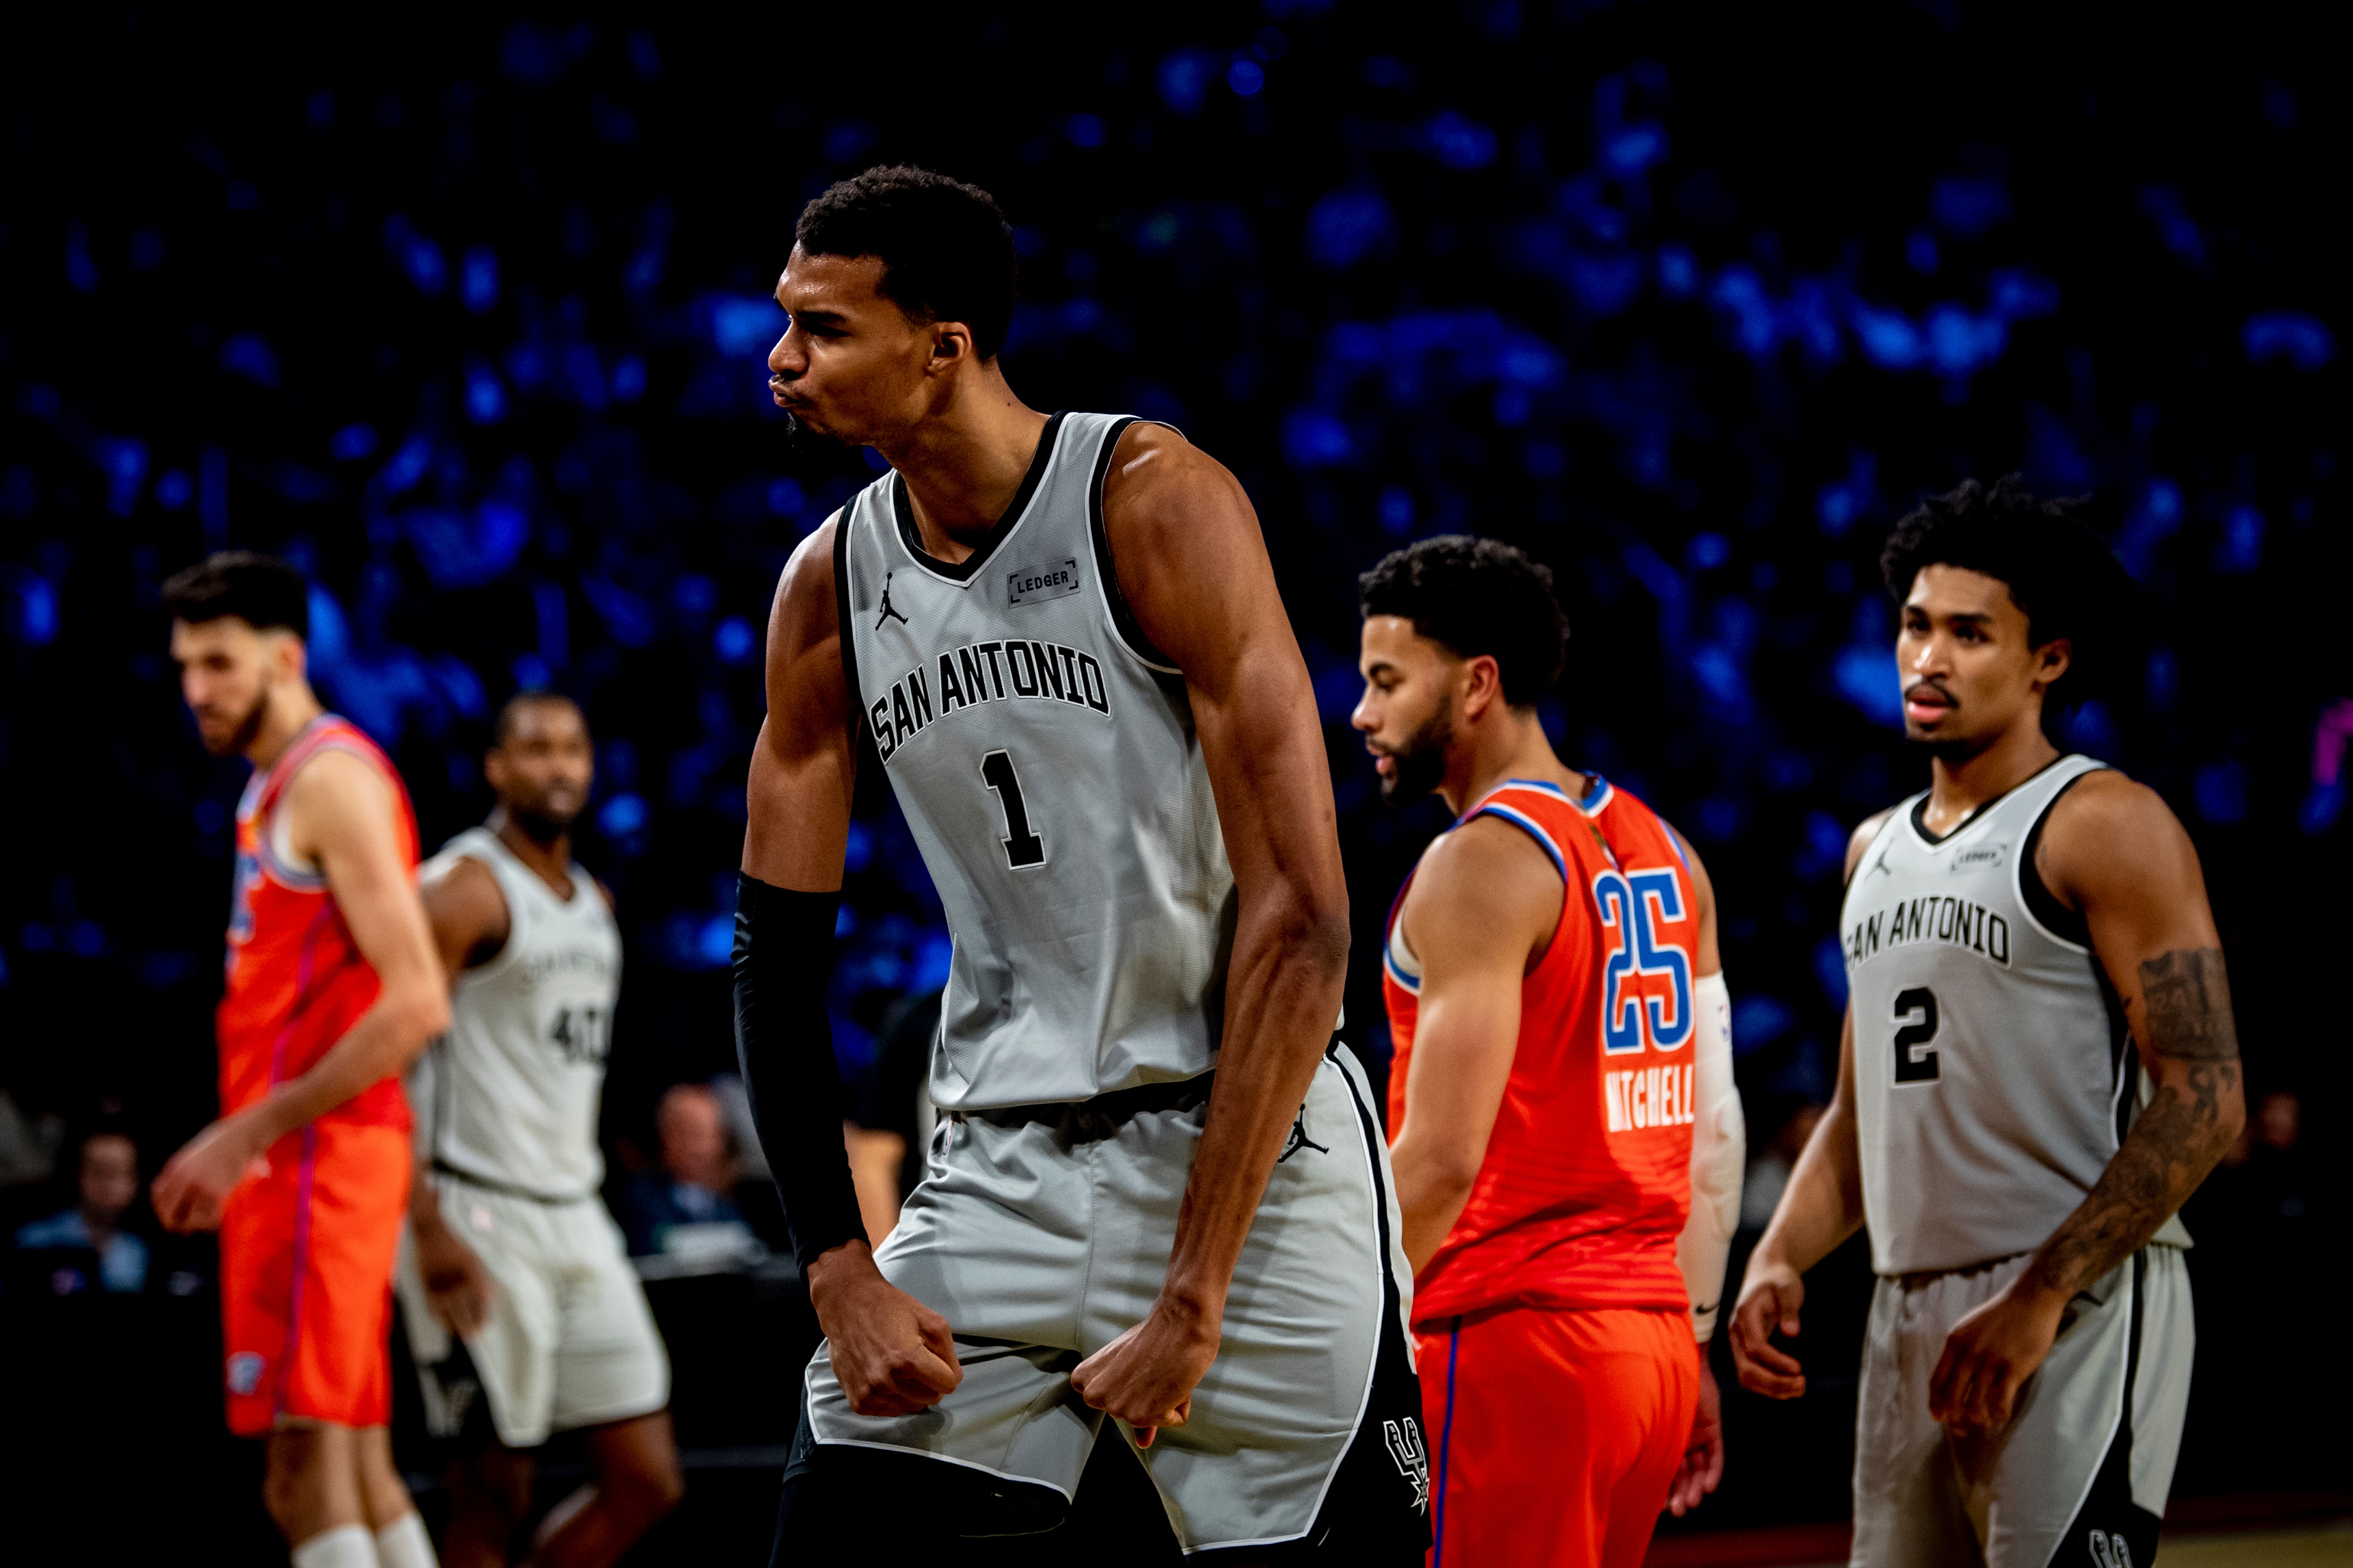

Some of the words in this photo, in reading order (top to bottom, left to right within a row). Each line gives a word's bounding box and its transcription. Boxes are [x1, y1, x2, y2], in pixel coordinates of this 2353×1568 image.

[1017, 570, 1069, 594] LEDGER
[870, 664, 935, 766] SAN
[937, 639, 1111, 718] ANTONIO
[979, 749, 1047, 870] 1
[1592, 866, 1695, 1056] 25
[1887, 893, 2012, 970] ANTONIO
[1891, 984, 1942, 1088] 2
